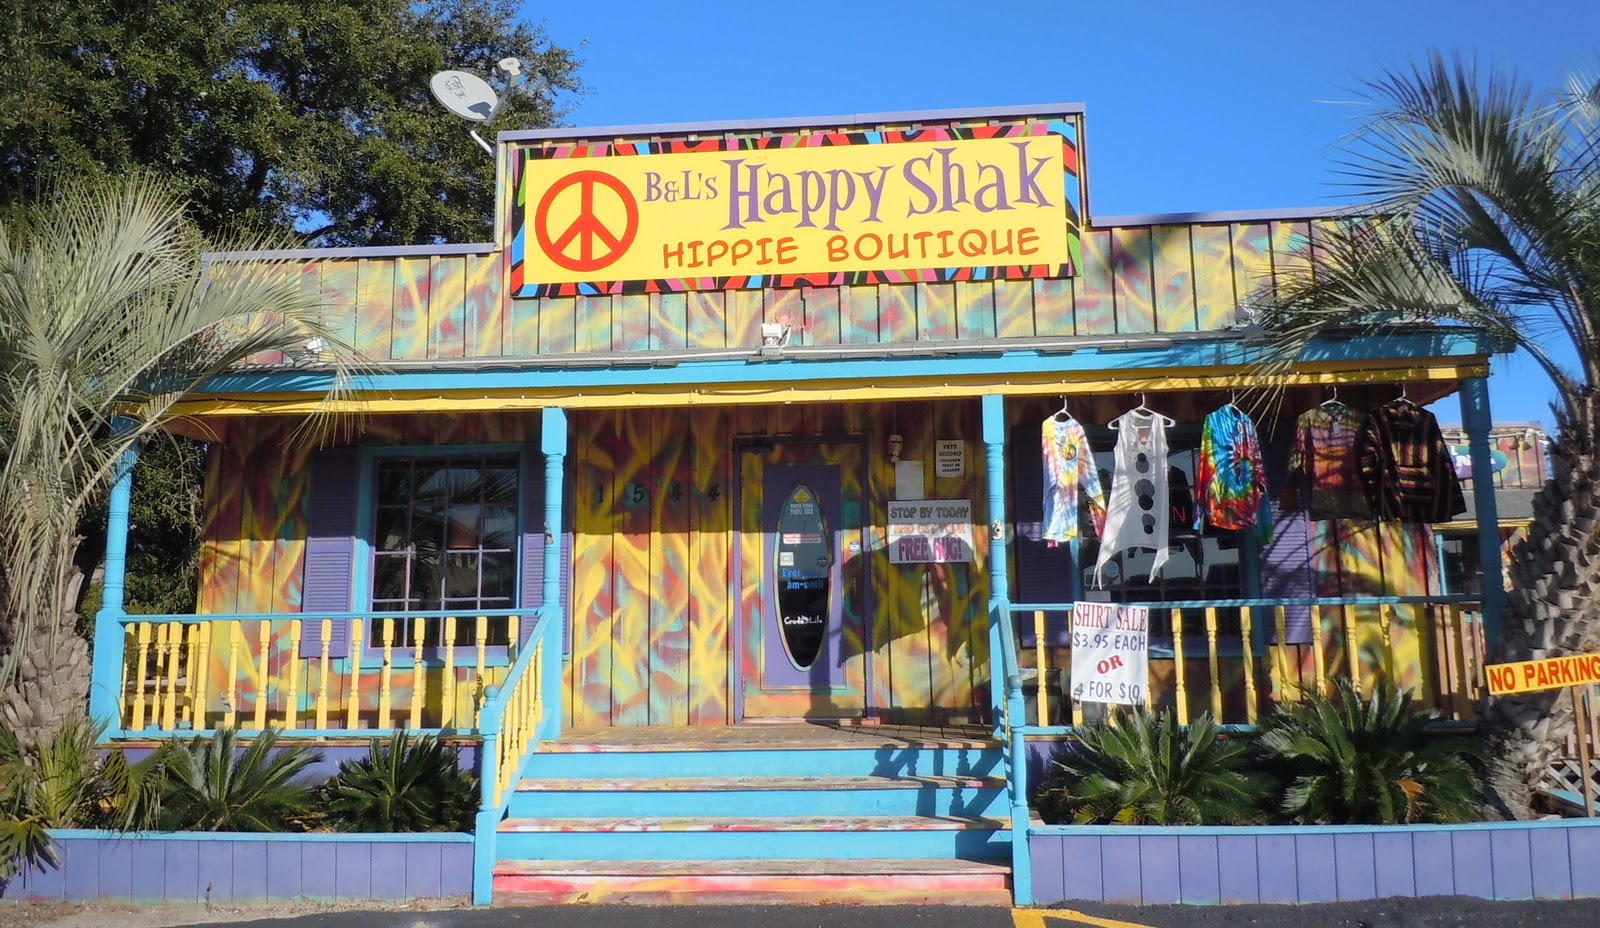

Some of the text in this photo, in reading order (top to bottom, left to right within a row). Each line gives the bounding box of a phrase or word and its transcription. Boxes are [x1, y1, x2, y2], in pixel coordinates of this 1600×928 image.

[643, 140, 1056, 231] B&L's Happy Shak
[663, 227, 1040, 268] HIPPIE BOUTIQUE
[890, 506, 969, 519] STOP BY TODAY
[894, 522, 966, 534] AND GET YOUR
[898, 537, 963, 561] FREE HUG!
[1074, 603, 1147, 632] SHIRT SALE
[1073, 631, 1146, 651] $3.95 EACH
[1096, 654, 1124, 674] OR
[1489, 655, 1600, 692] NO PARKING
[1089, 681, 1112, 698] FOR
[1119, 682, 1140, 699] $10
